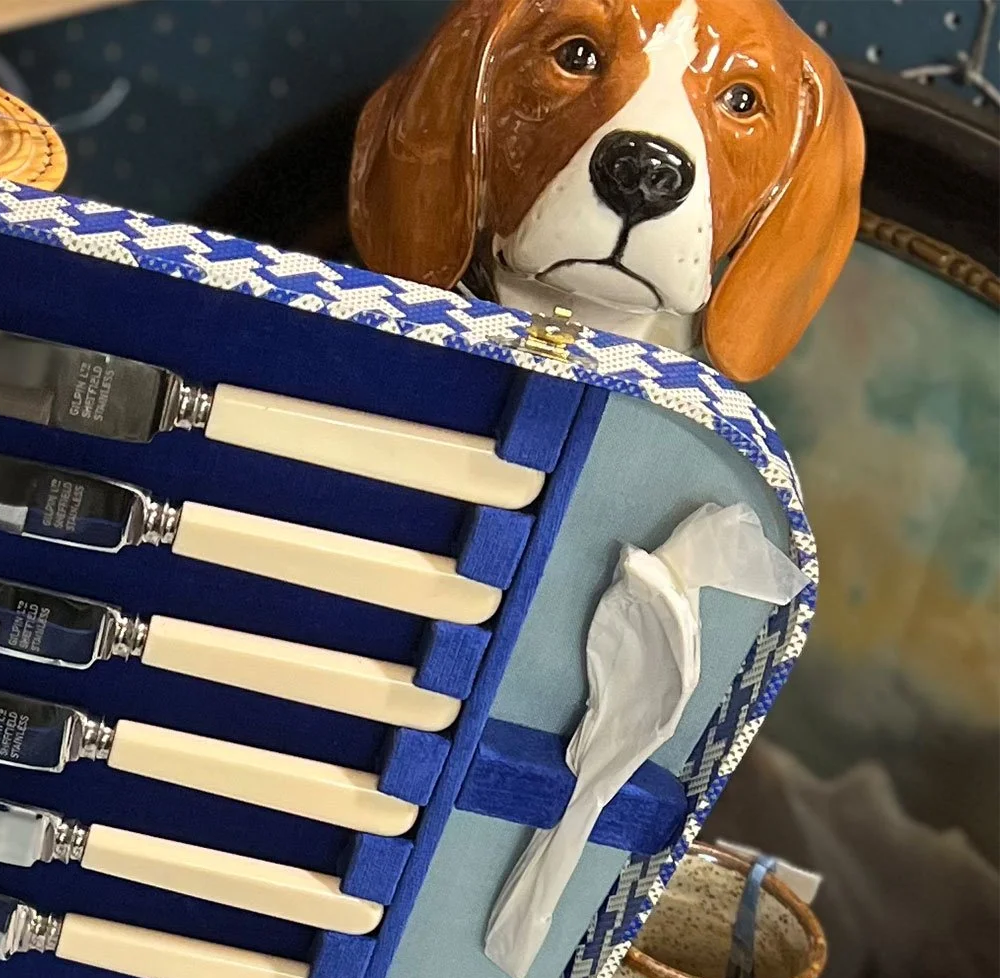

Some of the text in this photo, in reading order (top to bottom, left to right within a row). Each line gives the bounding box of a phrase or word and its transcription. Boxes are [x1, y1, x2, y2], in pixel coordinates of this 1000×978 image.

[69, 380, 87, 416] GILPIN
[93, 370, 115, 421] STAINLESS
[8, 615, 24, 646] GILPIN
[10, 715, 30, 759] STAINLESS
